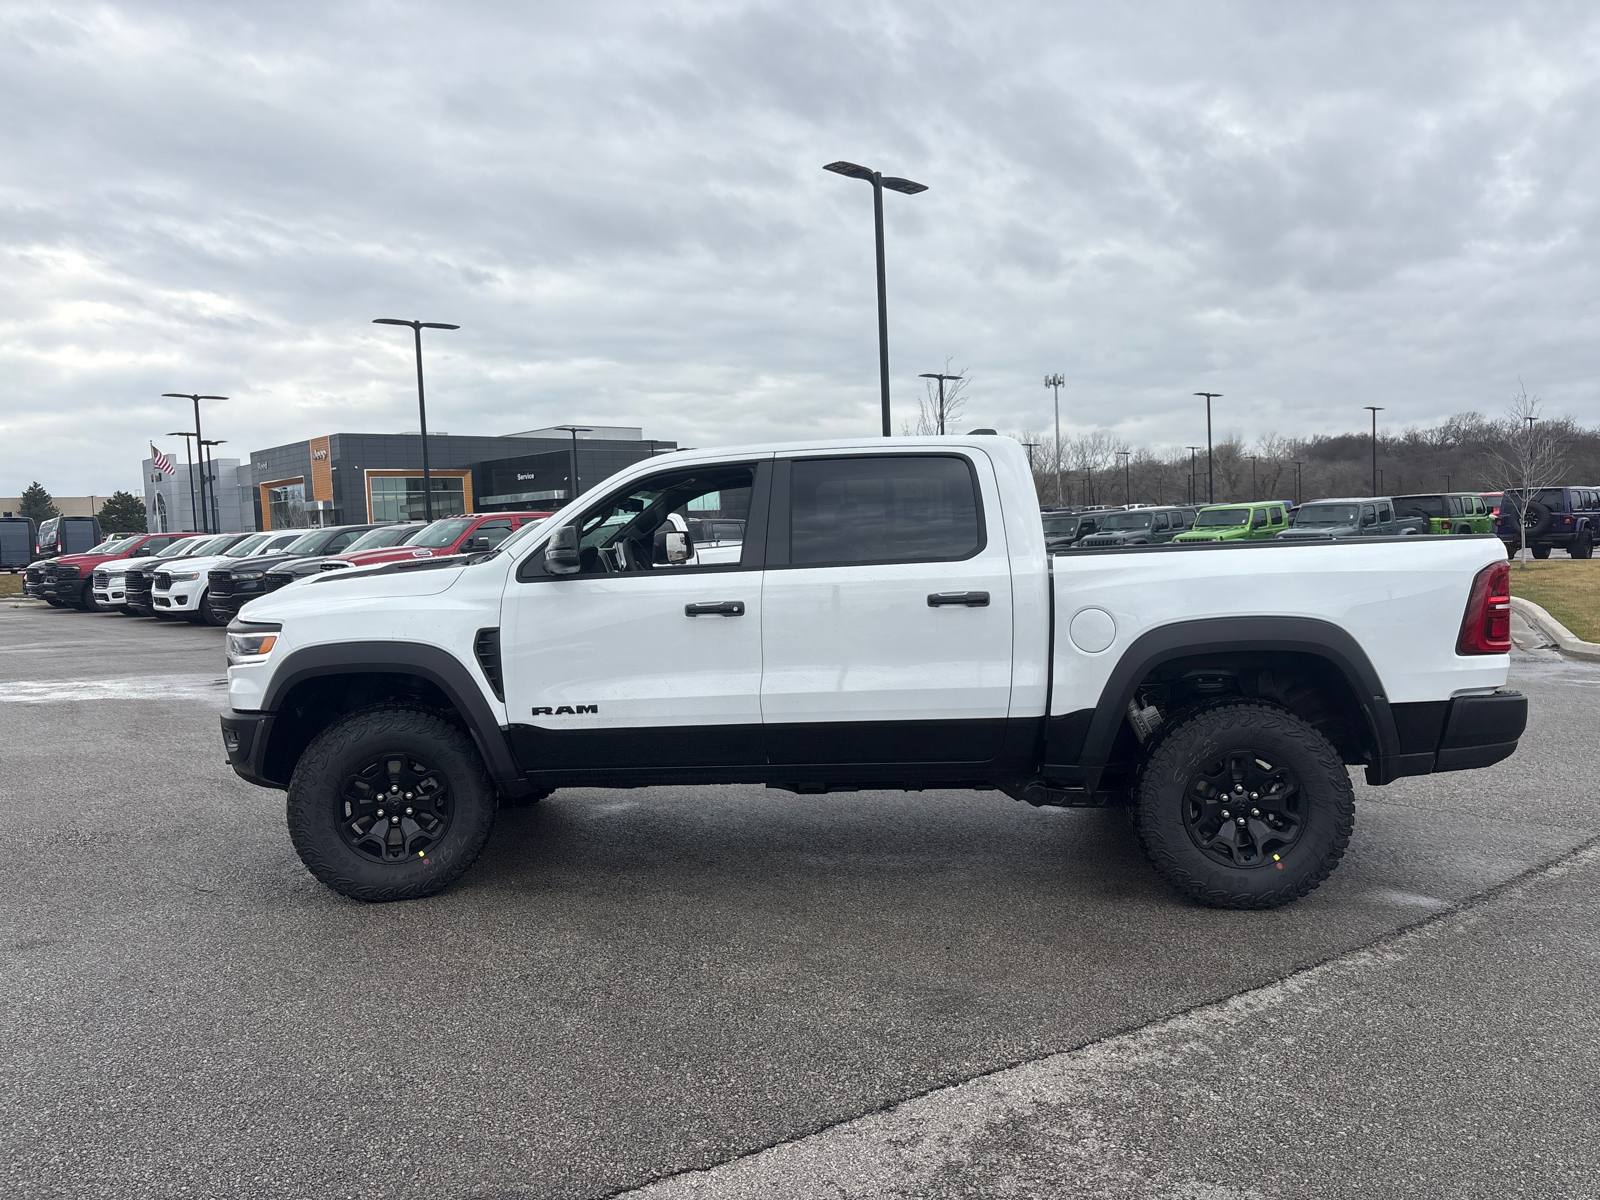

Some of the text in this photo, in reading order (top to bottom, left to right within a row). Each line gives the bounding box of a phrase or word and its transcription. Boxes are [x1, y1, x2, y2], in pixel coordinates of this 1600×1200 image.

[313, 449, 327, 461] Jeep
[517, 473, 535, 481] Service
[532, 704, 598, 716] RAM
